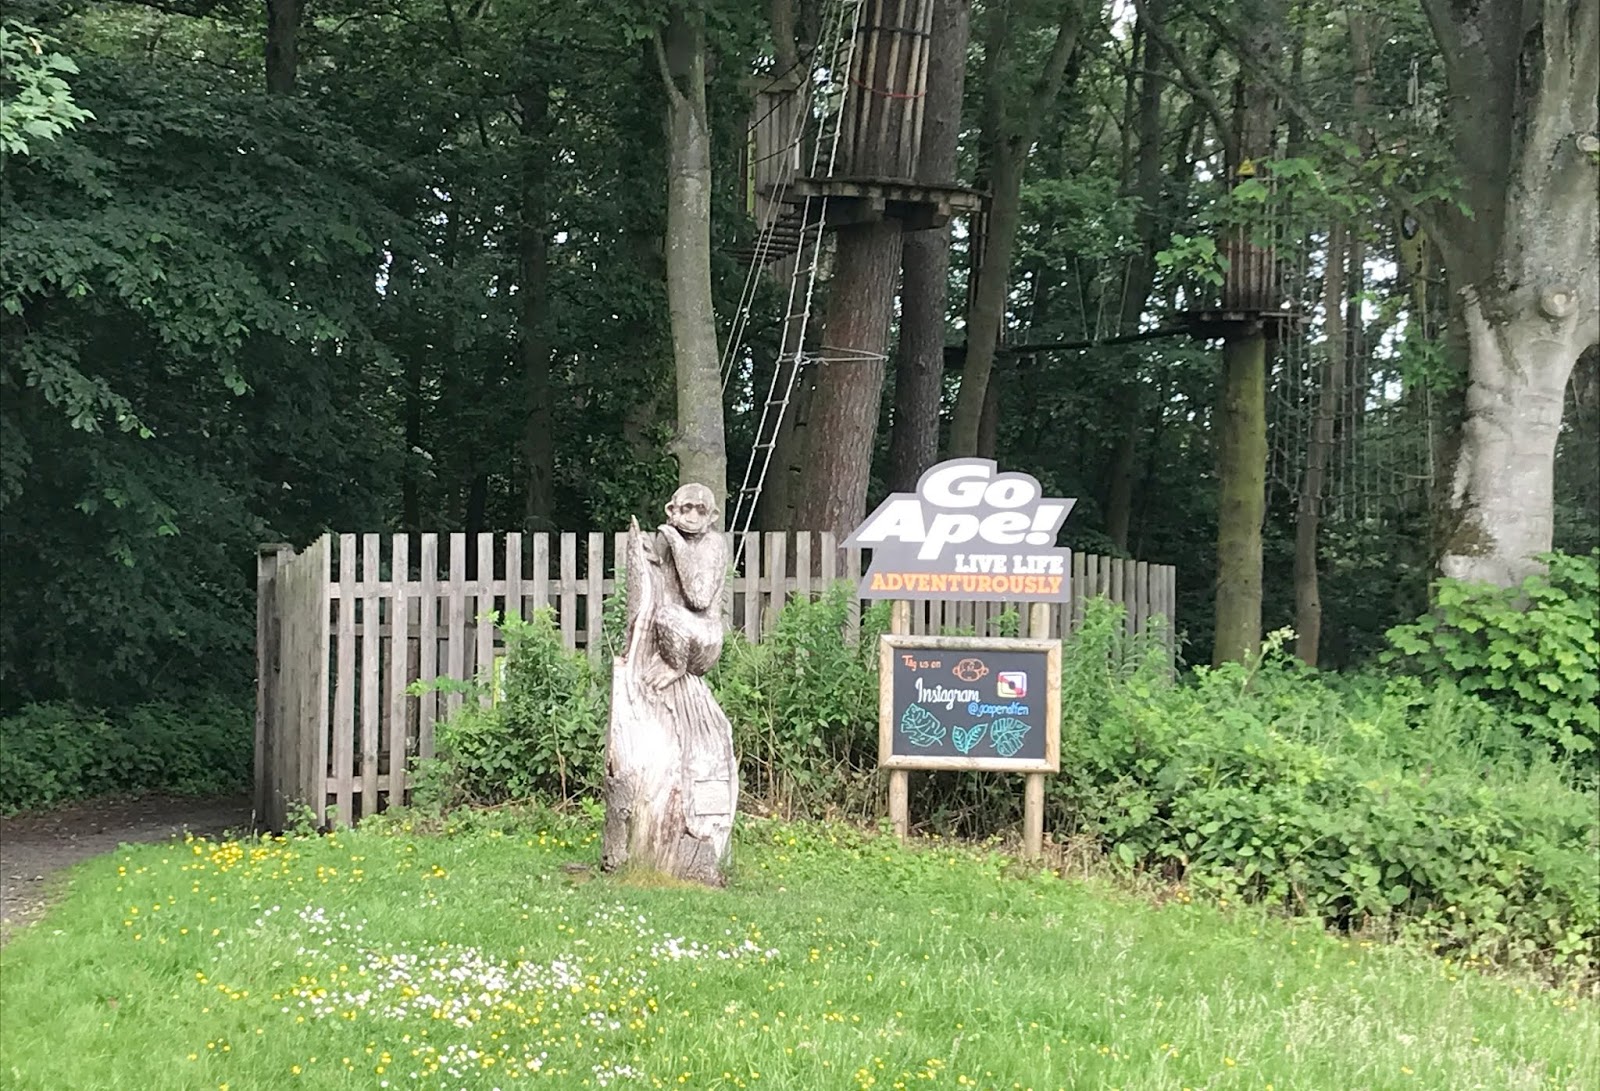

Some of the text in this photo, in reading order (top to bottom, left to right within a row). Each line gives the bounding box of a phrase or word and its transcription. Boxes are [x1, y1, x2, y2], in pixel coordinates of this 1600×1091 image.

[922, 464, 1035, 509] Go
[856, 499, 1065, 560] Ape!
[954, 553, 1064, 575] LIVE LIFE
[870, 572, 1063, 594] ADVENTUROUSLY
[919, 660, 929, 669] us
[915, 677, 981, 710] Instagram
